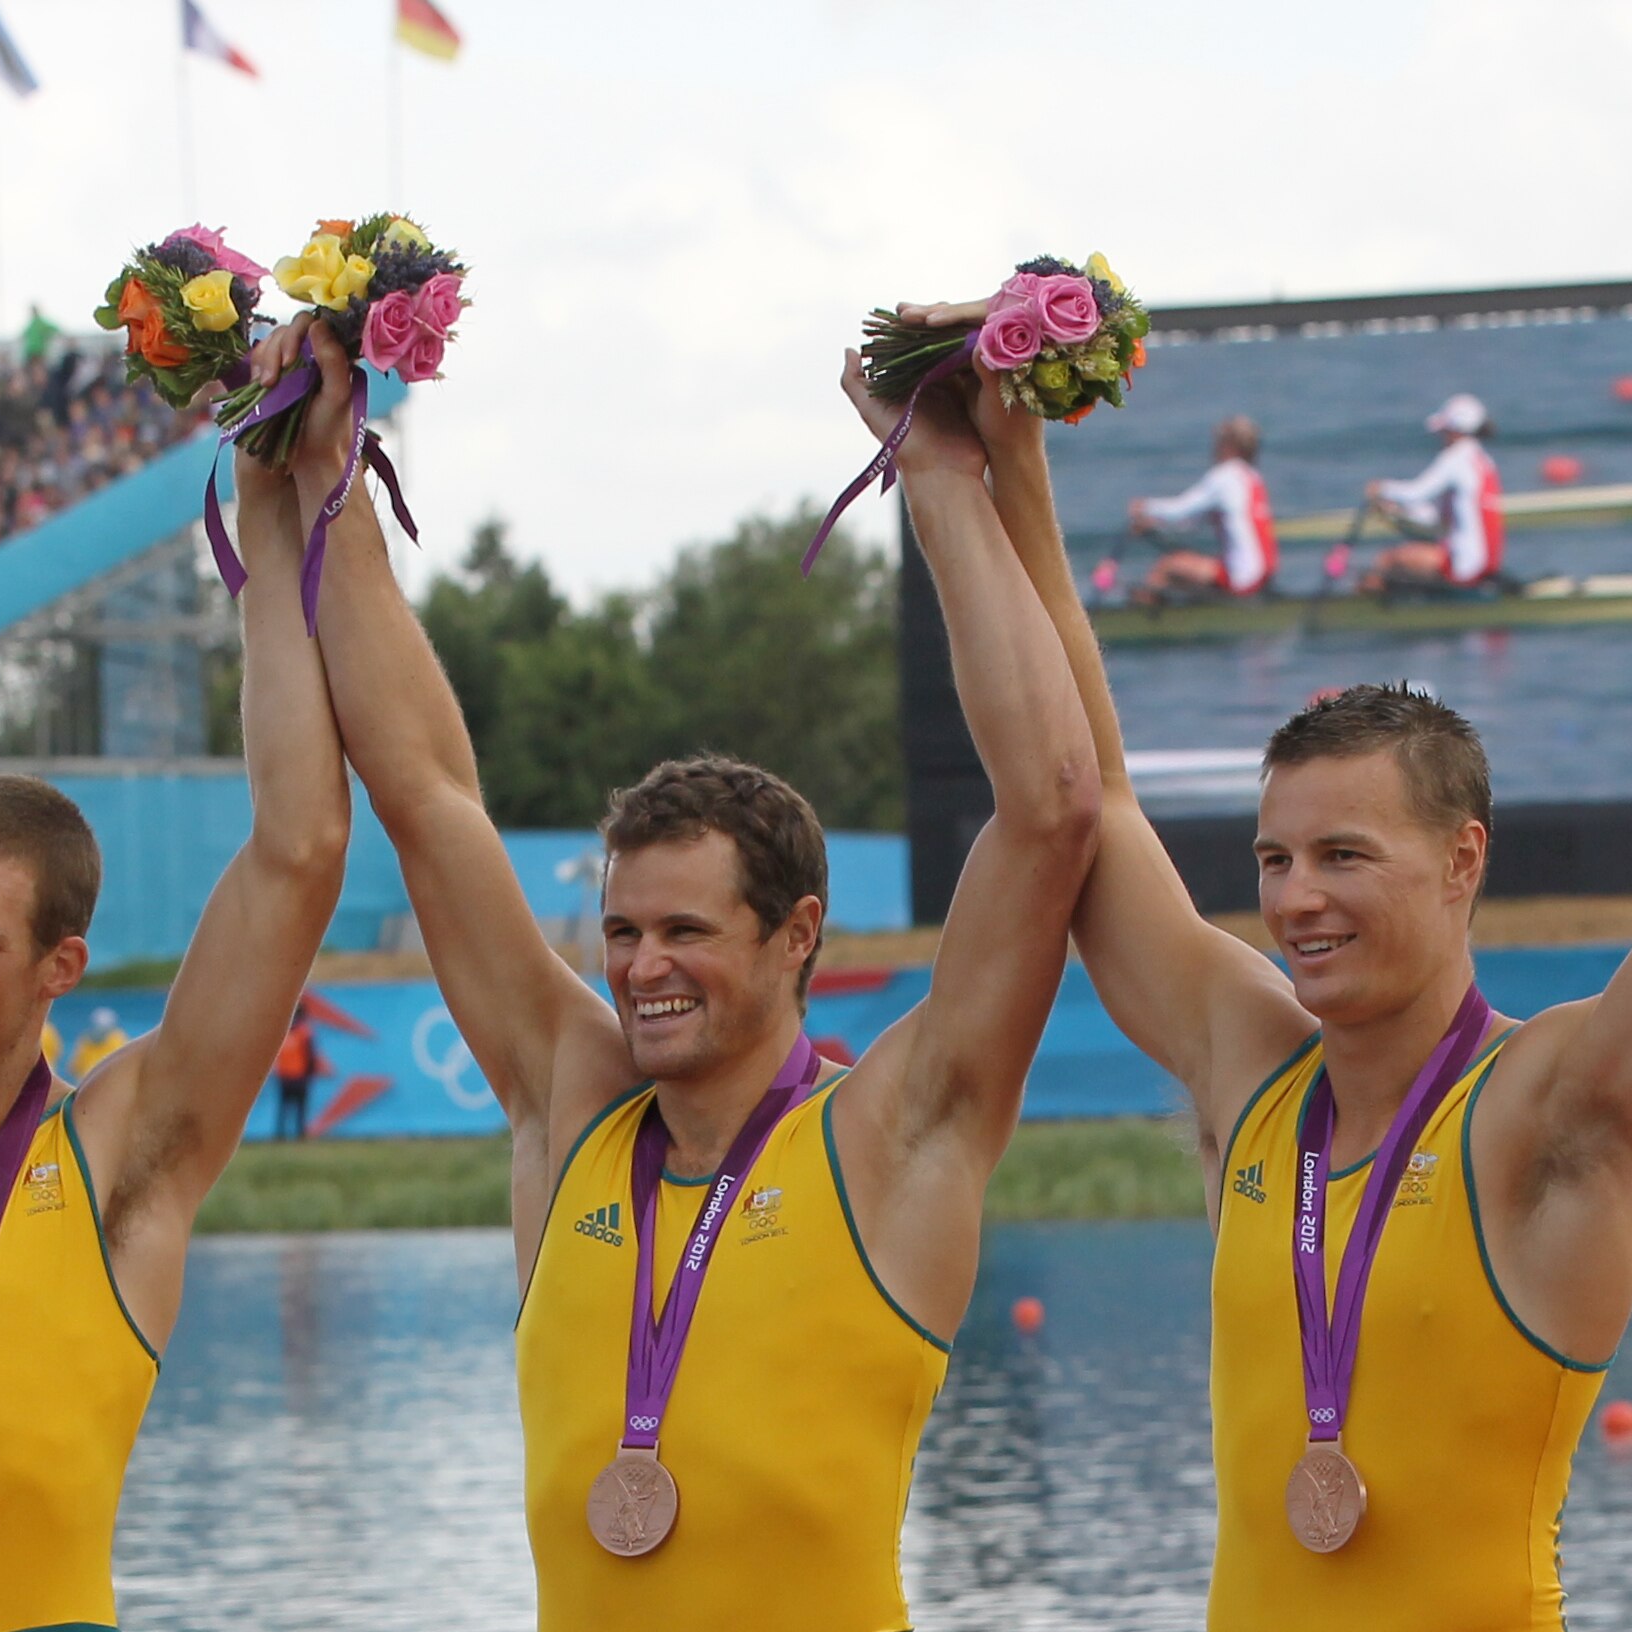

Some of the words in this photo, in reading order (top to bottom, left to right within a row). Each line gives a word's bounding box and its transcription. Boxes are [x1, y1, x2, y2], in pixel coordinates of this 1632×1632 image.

[866, 446, 894, 481] 2012
[1302, 1151, 1320, 1211] London
[700, 1174, 736, 1231] London
[574, 1220, 624, 1247] adidas
[685, 1233, 710, 1271] 2012
[1300, 1214, 1316, 1254] 2012
